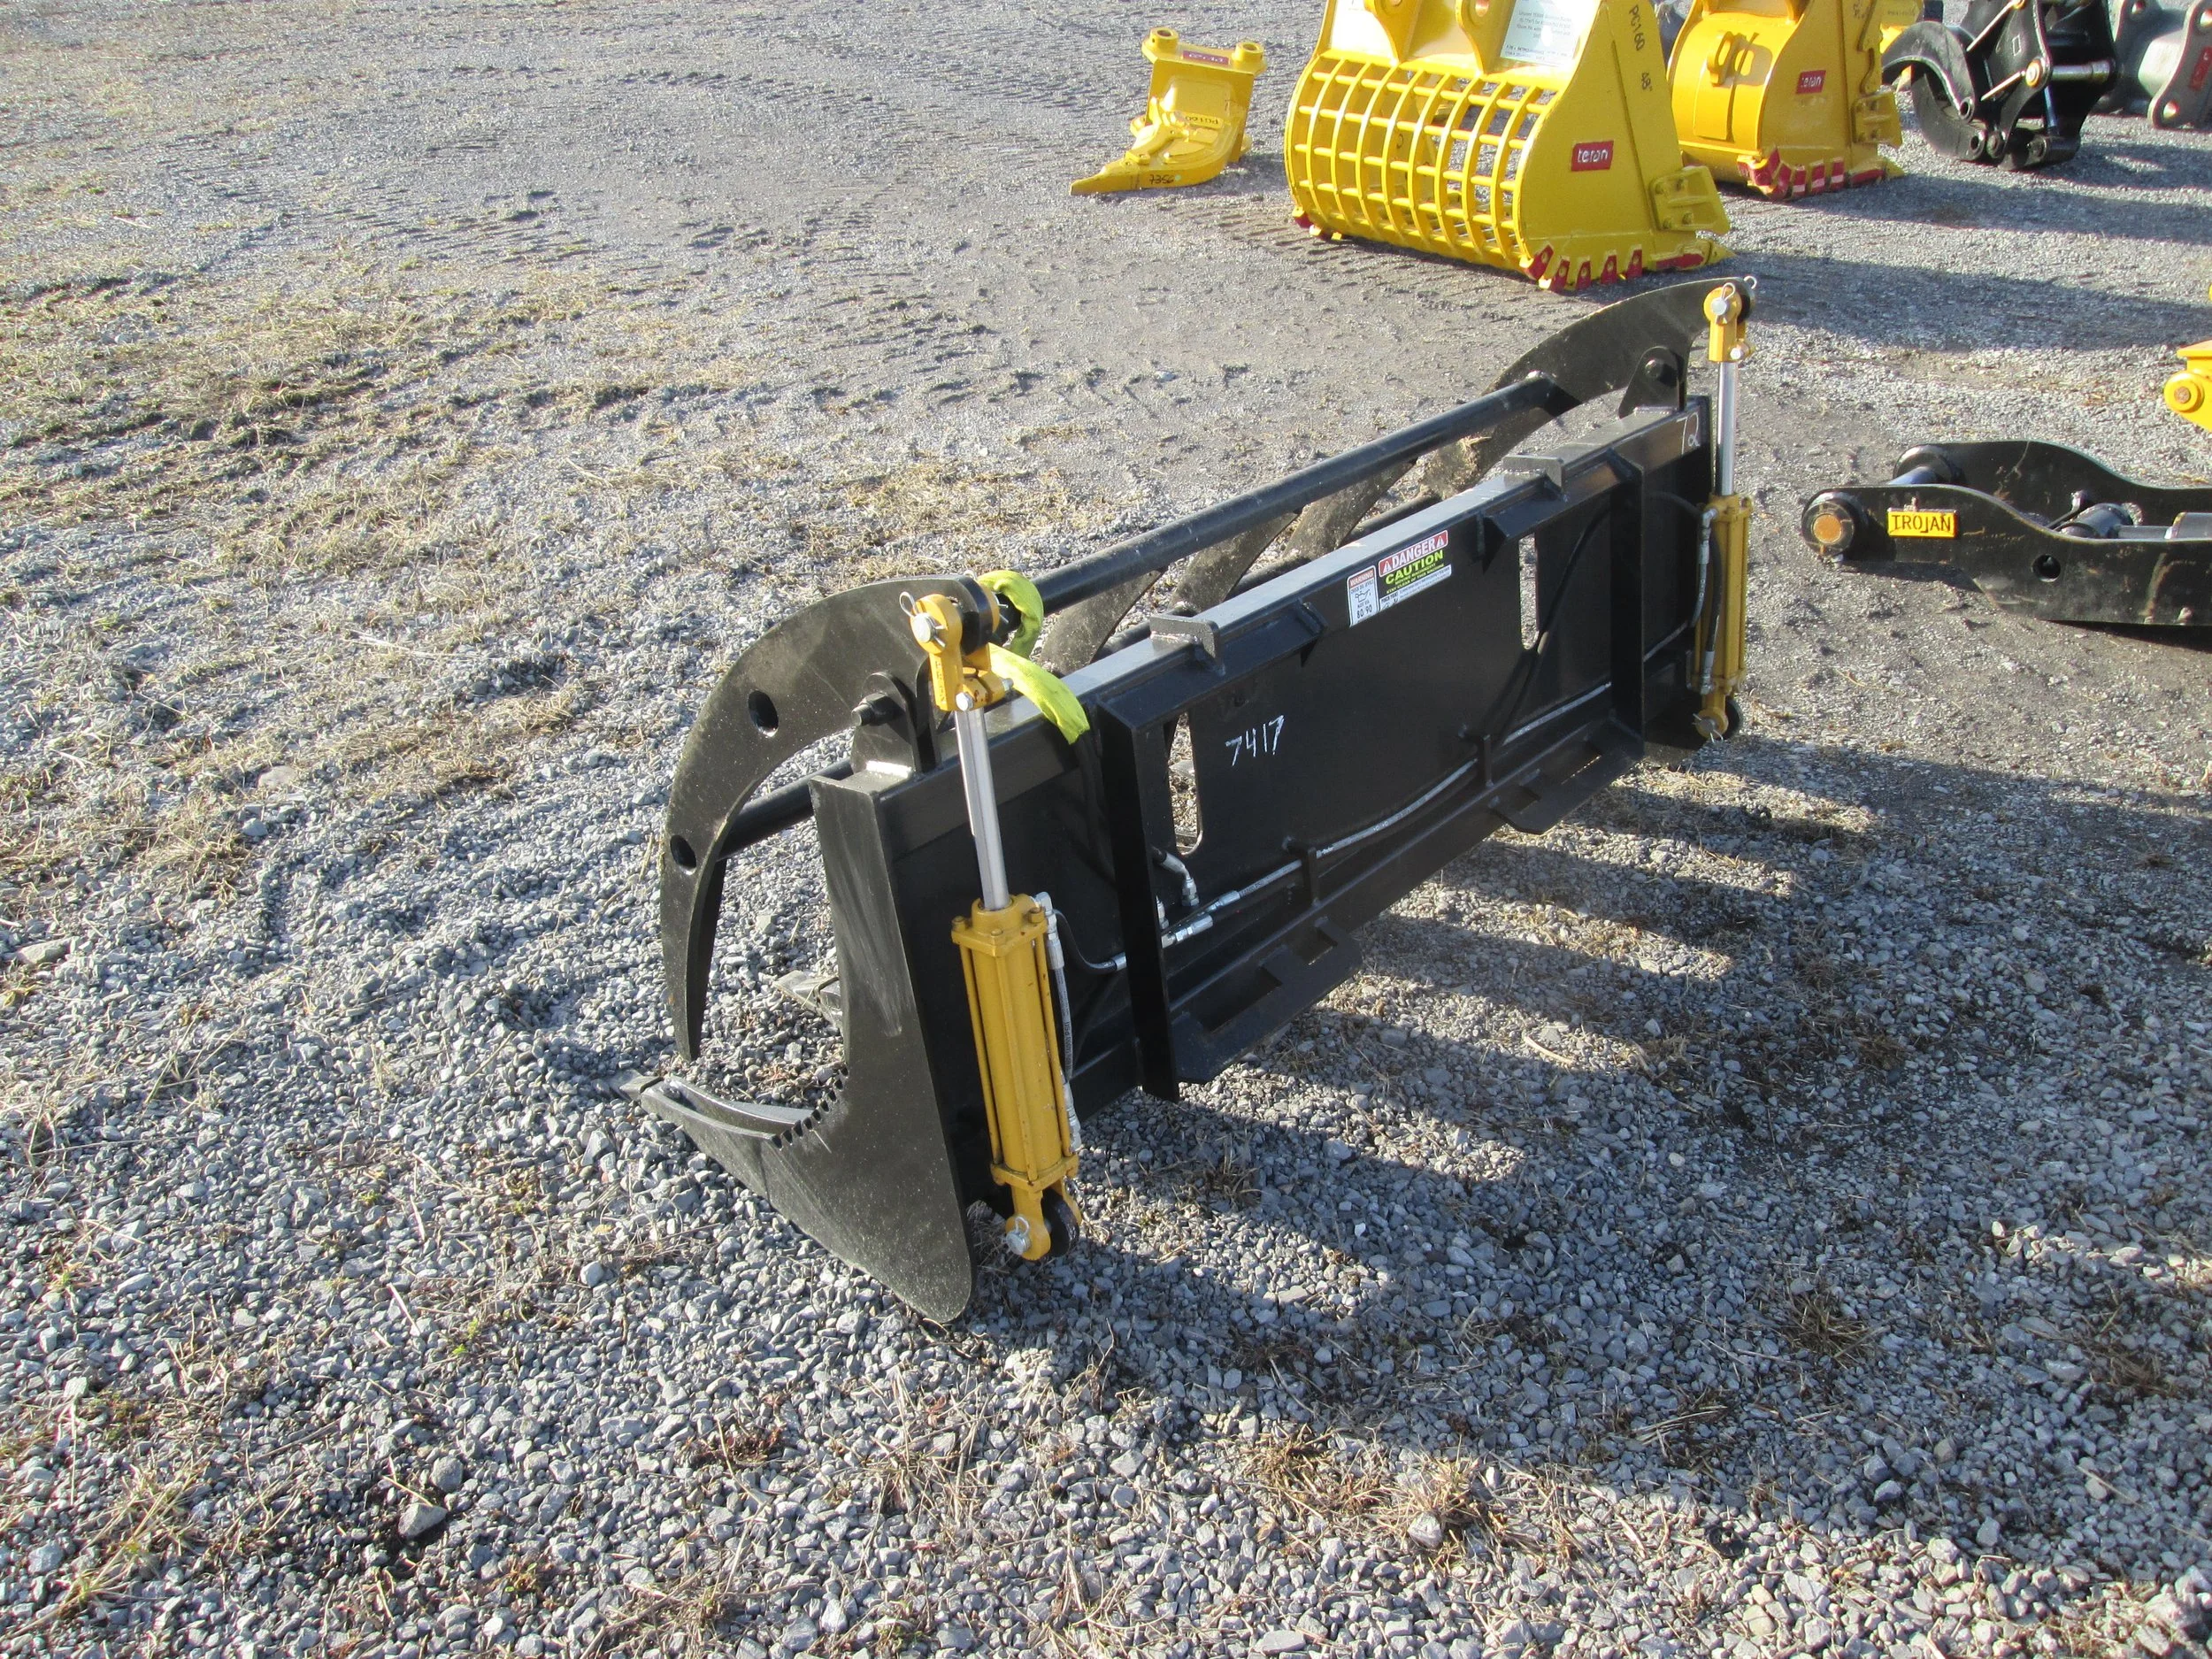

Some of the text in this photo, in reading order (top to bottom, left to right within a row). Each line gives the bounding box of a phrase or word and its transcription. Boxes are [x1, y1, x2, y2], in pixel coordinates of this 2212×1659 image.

[1577, 148, 1609, 163] teron
[1891, 514, 1951, 534] TROJAN
[1392, 538, 1435, 569] DANGER
[1350, 569, 1374, 588] WARNING
[1386, 549, 1443, 584] CAUTION
[1225, 715, 1285, 767] 7417
